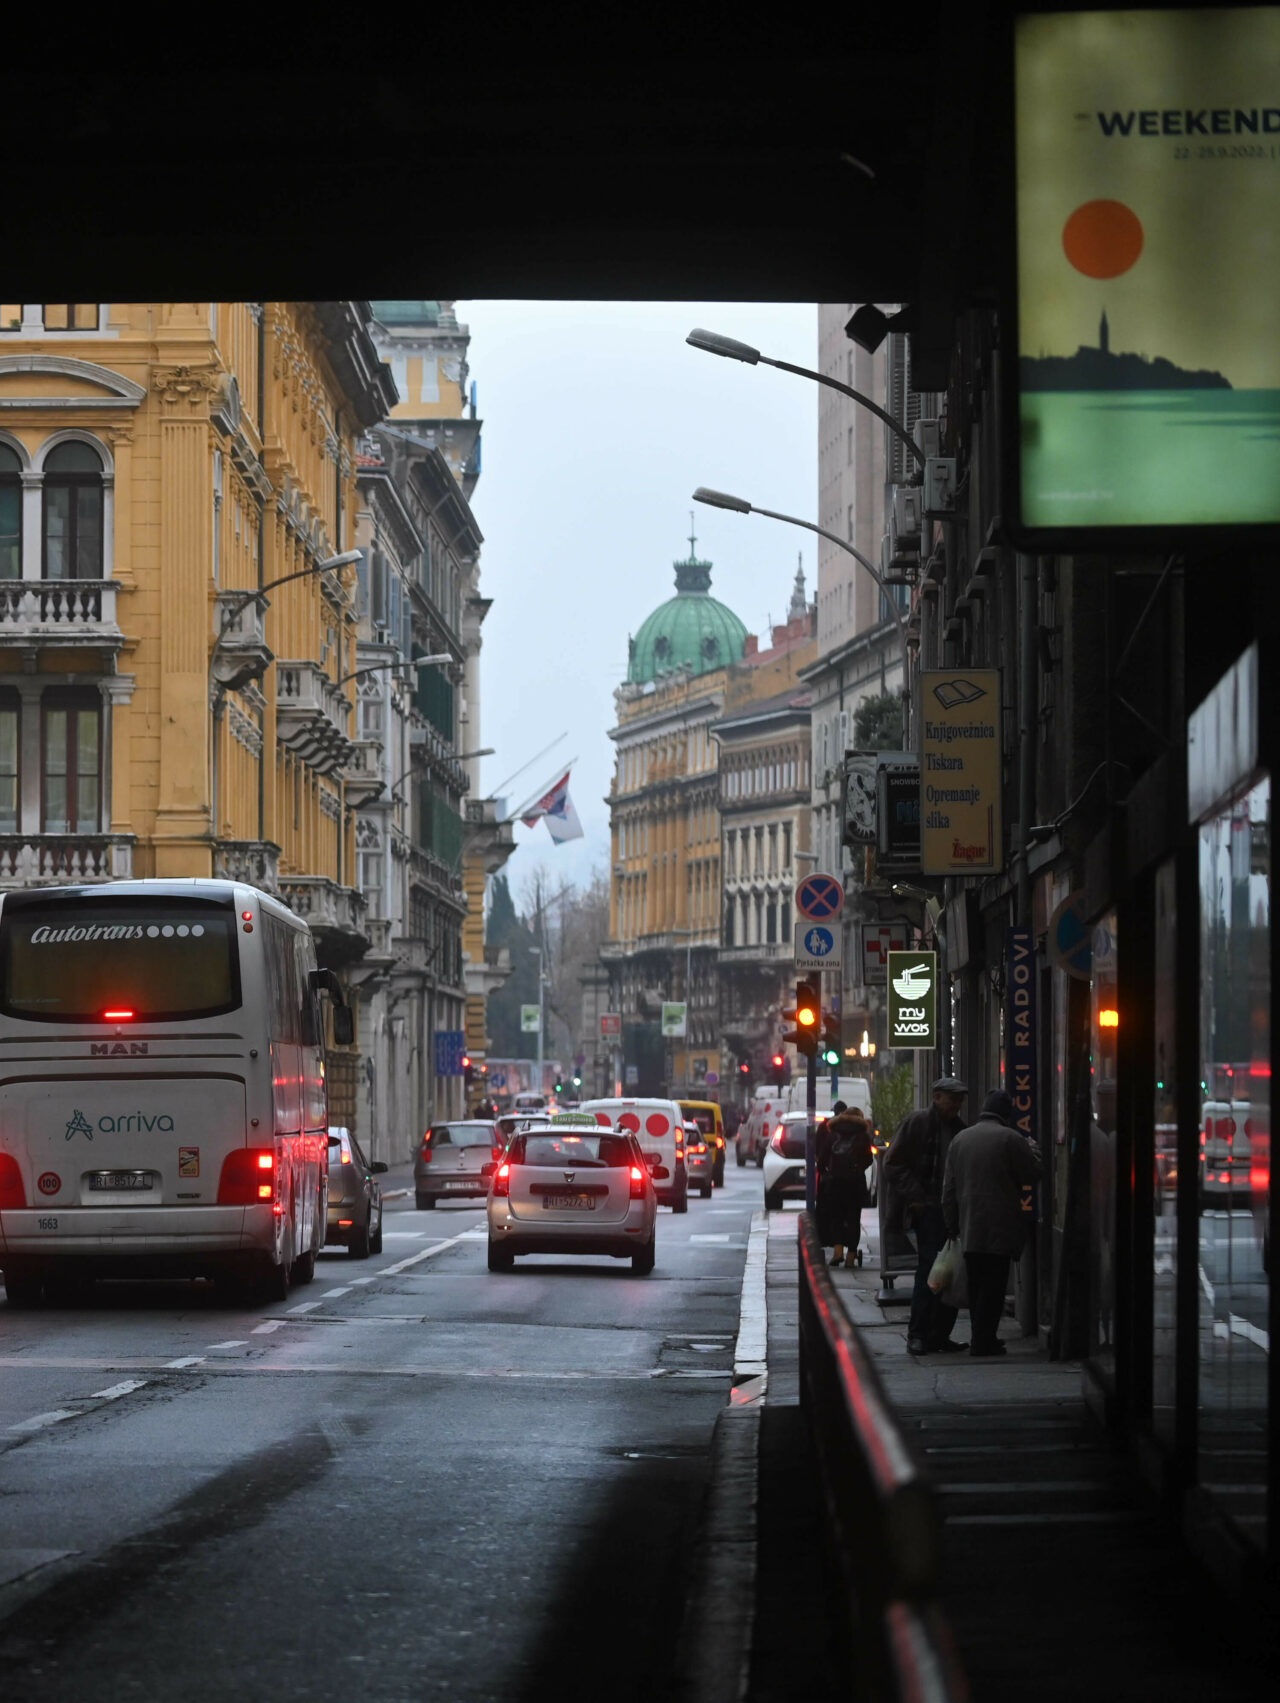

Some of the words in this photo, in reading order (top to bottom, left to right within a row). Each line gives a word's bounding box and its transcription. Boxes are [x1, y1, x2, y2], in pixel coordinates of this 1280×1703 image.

[1097, 108, 1280, 136] WEEKEND
[925, 722, 994, 742] Knjigovežnica
[925, 753, 963, 770] Tiskara
[926, 785, 980, 805] Opremanje
[926, 811, 950, 828] slika
[1014, 933, 1031, 1047] RADOVI
[898, 1007, 925, 1020] my
[894, 1023, 930, 1036] wok
[90, 1043, 148, 1055] MAN
[98, 1111, 175, 1133] arriva
[42, 1178, 57, 1189] 100
[96, 1175, 107, 1186] RI
[38, 1218, 58, 1230] 1663
